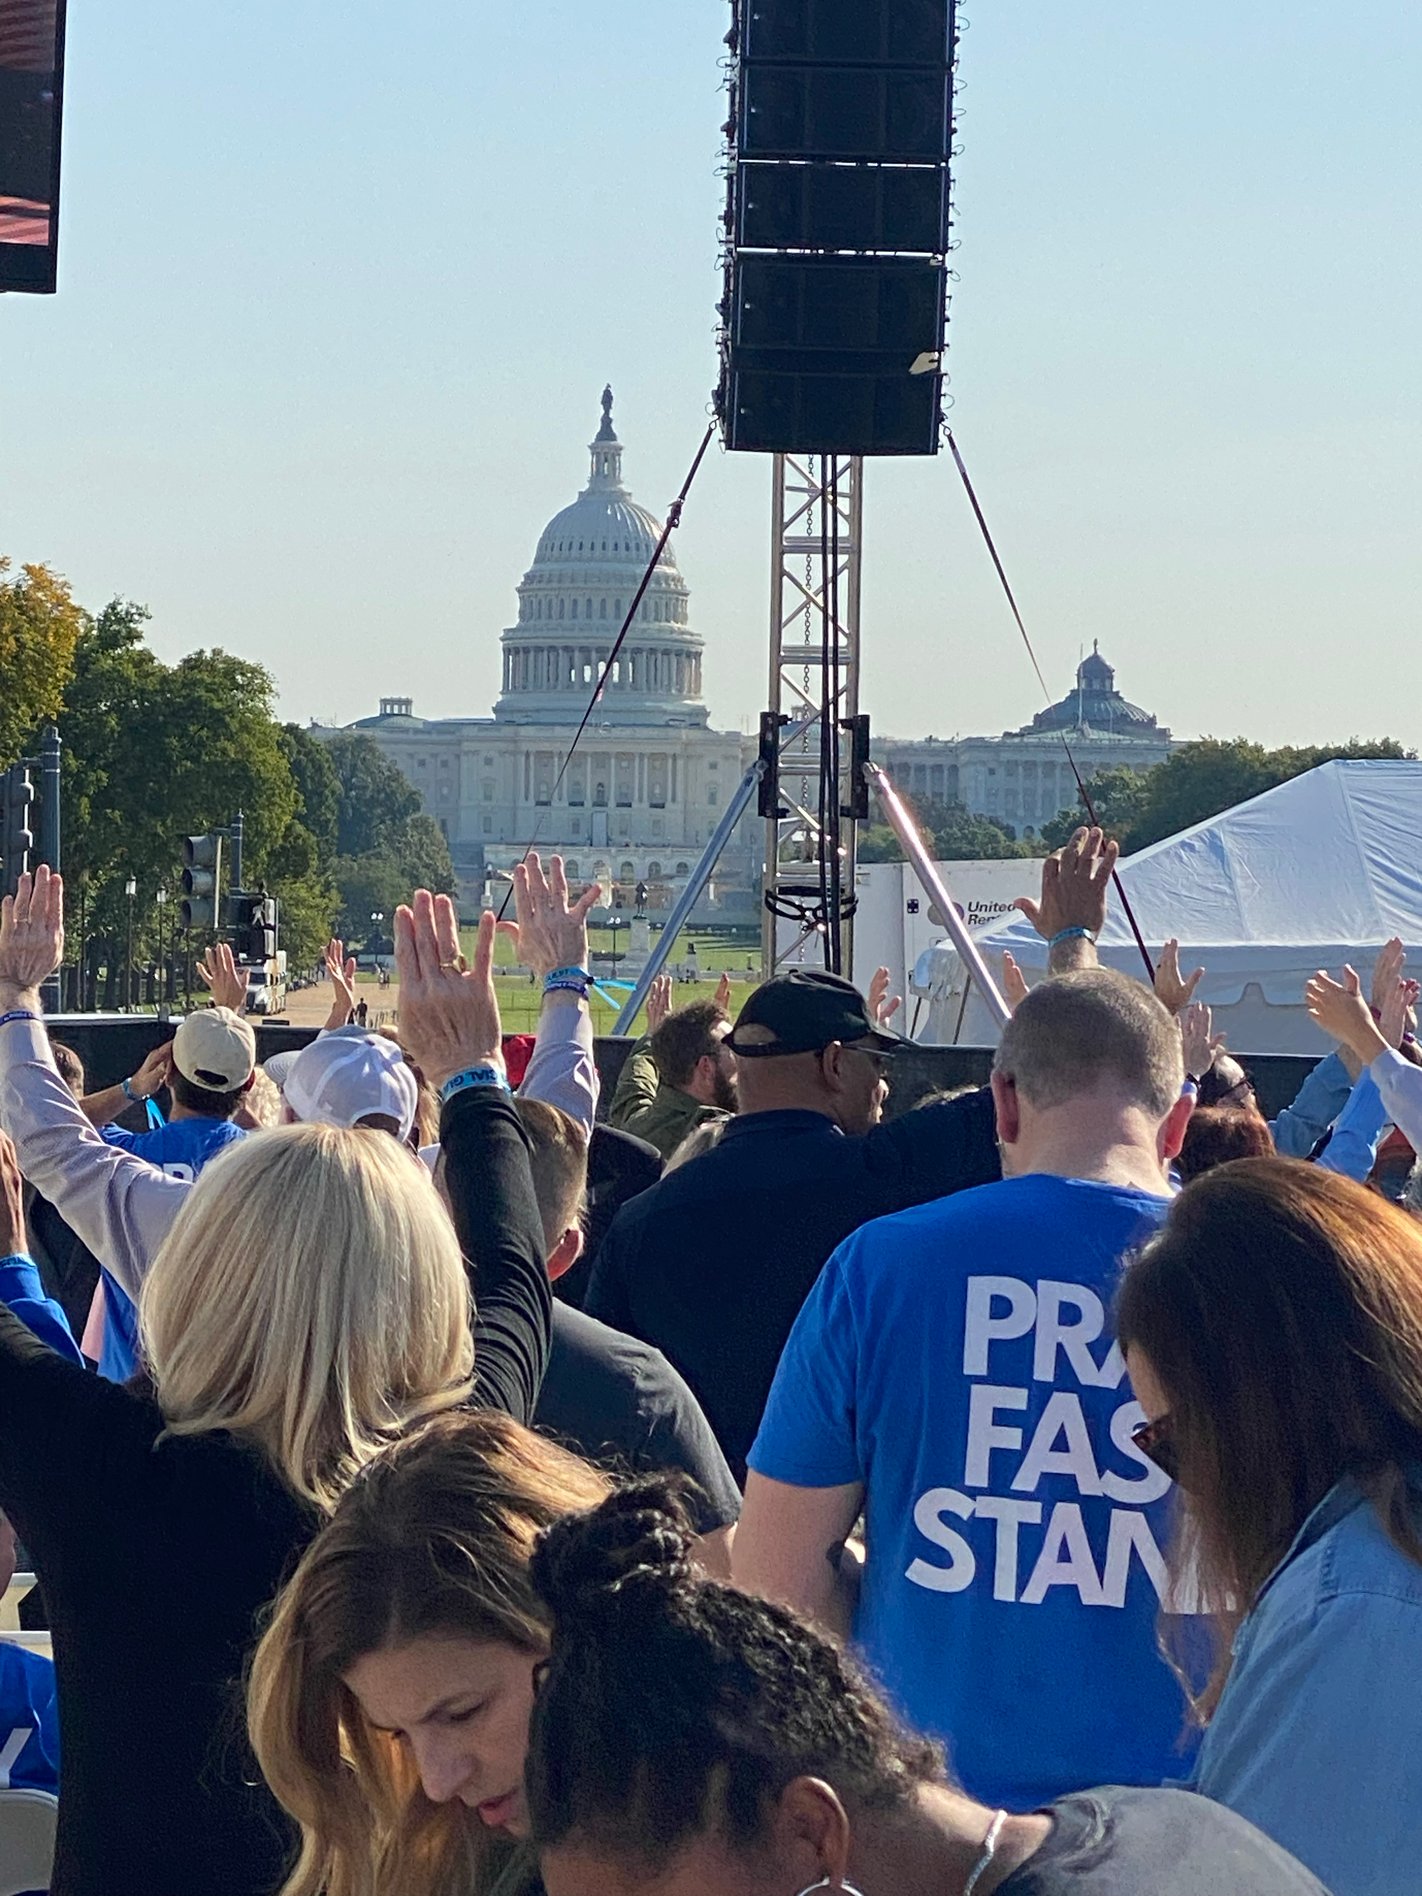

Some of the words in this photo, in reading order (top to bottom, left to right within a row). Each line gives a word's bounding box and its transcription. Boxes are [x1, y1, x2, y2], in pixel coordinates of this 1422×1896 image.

[967, 901, 1016, 913] United
[962, 1275, 1128, 1389] PR
[964, 1384, 1173, 1505] FAS
[904, 1487, 1236, 1614] STAN
